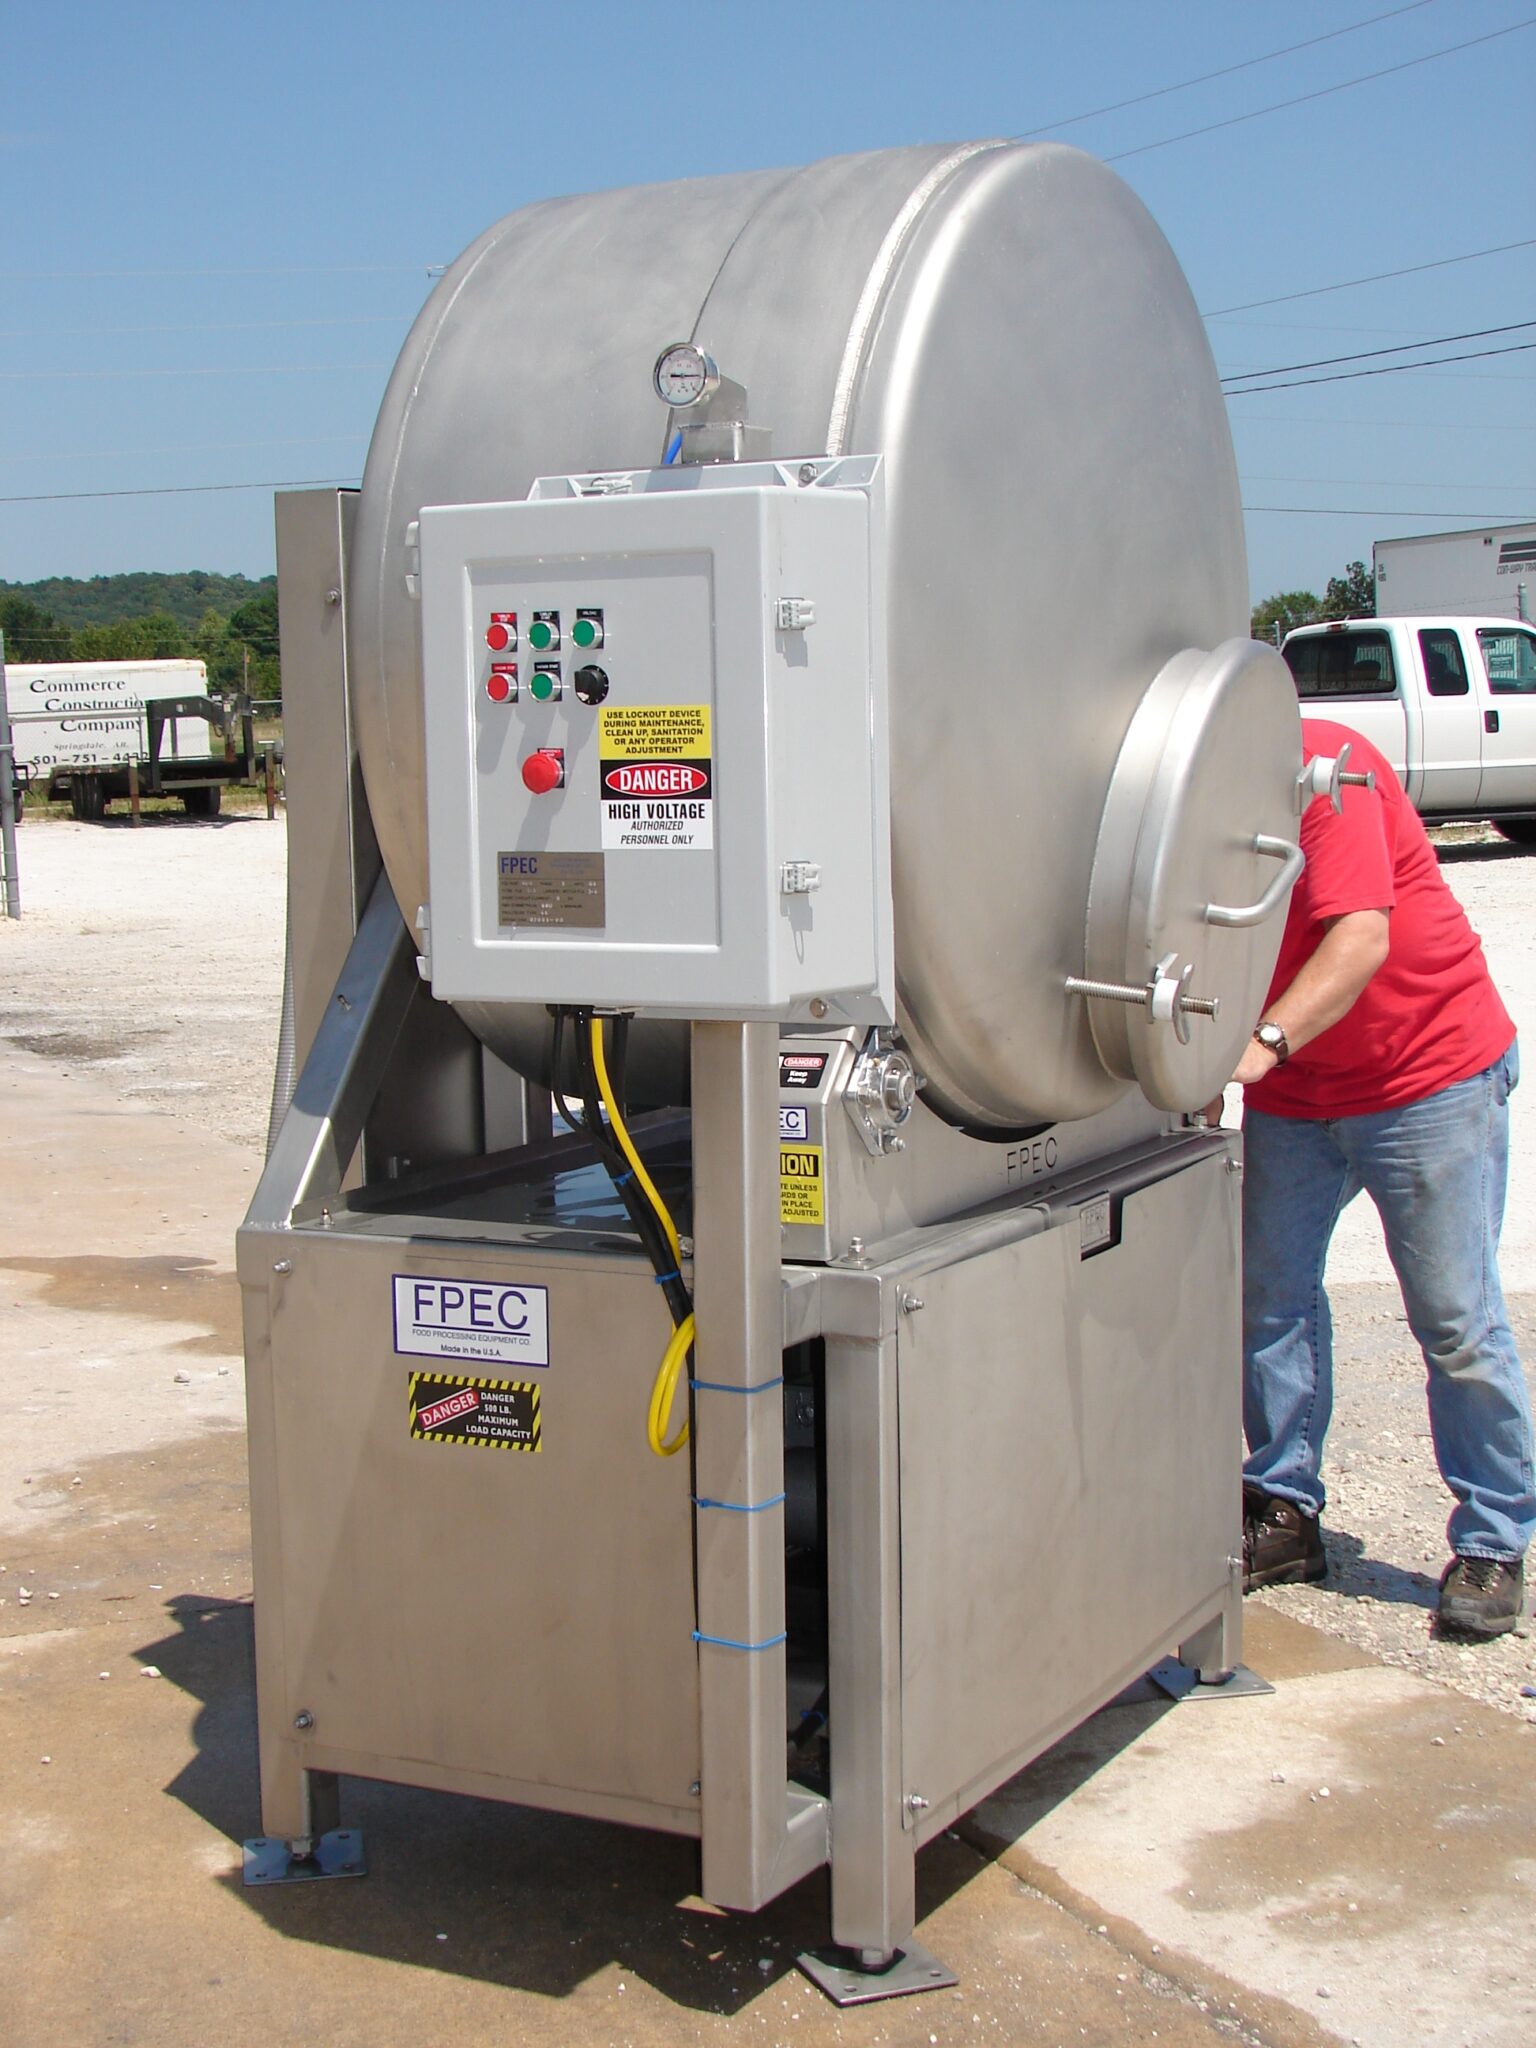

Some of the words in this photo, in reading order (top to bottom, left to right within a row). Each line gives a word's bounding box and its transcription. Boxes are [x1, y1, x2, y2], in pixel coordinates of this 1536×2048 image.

[30, 679, 126, 693] Commerce
[45, 696, 144, 711] Constructio
[606, 711, 624, 719] USE
[626, 710, 667, 719] LOCKOUT
[669, 710, 701, 718] DEVICE
[60, 718, 142, 733] Company
[604, 720, 637, 728] DURING
[639, 719, 705, 728] MAINTENANCE,
[605, 729, 634, 737] CLEAN
[636, 729, 649, 737] UP,
[651, 728, 703, 736] SANITATION
[628, 737, 646, 745] ANY
[650, 737, 695, 745] OPERATOR
[625, 746, 684, 754] ADJUSTMENT
[619, 769, 693, 791] DANGER
[608, 803, 641, 819] HIGH
[646, 803, 706, 819] VOLTAGE
[630, 821, 684, 831] AUTHORIZED
[620, 835, 669, 845] PERSONNEL
[672, 834, 694, 844] ONLY
[501, 857, 538, 874] FPEC
[787, 1058, 821, 1067] DANGER
[1006, 1136, 1058, 1185] FPEC
[789, 1183, 818, 1192] UNLESS
[790, 1200, 813, 1208] PLACE
[783, 1208, 820, 1217] ADJUSTED
[414, 1284, 528, 1330] FPEC
[412, 1329, 431, 1337] FOOD
[432, 1330, 477, 1341] PROCESSING
[478, 1335, 518, 1345] EQUIPMENT
[440, 1344, 461, 1353] Made
[462, 1345, 469, 1353] in
[470, 1346, 482, 1355] the
[483, 1347, 502, 1356] U.S.A.
[480, 1391, 515, 1403] DANGER
[421, 1393, 477, 1426] DANGER
[477, 1414, 519, 1427] MAXIMUM
[465, 1424, 489, 1435] LOAD
[490, 1427, 531, 1440] CAPACITY
